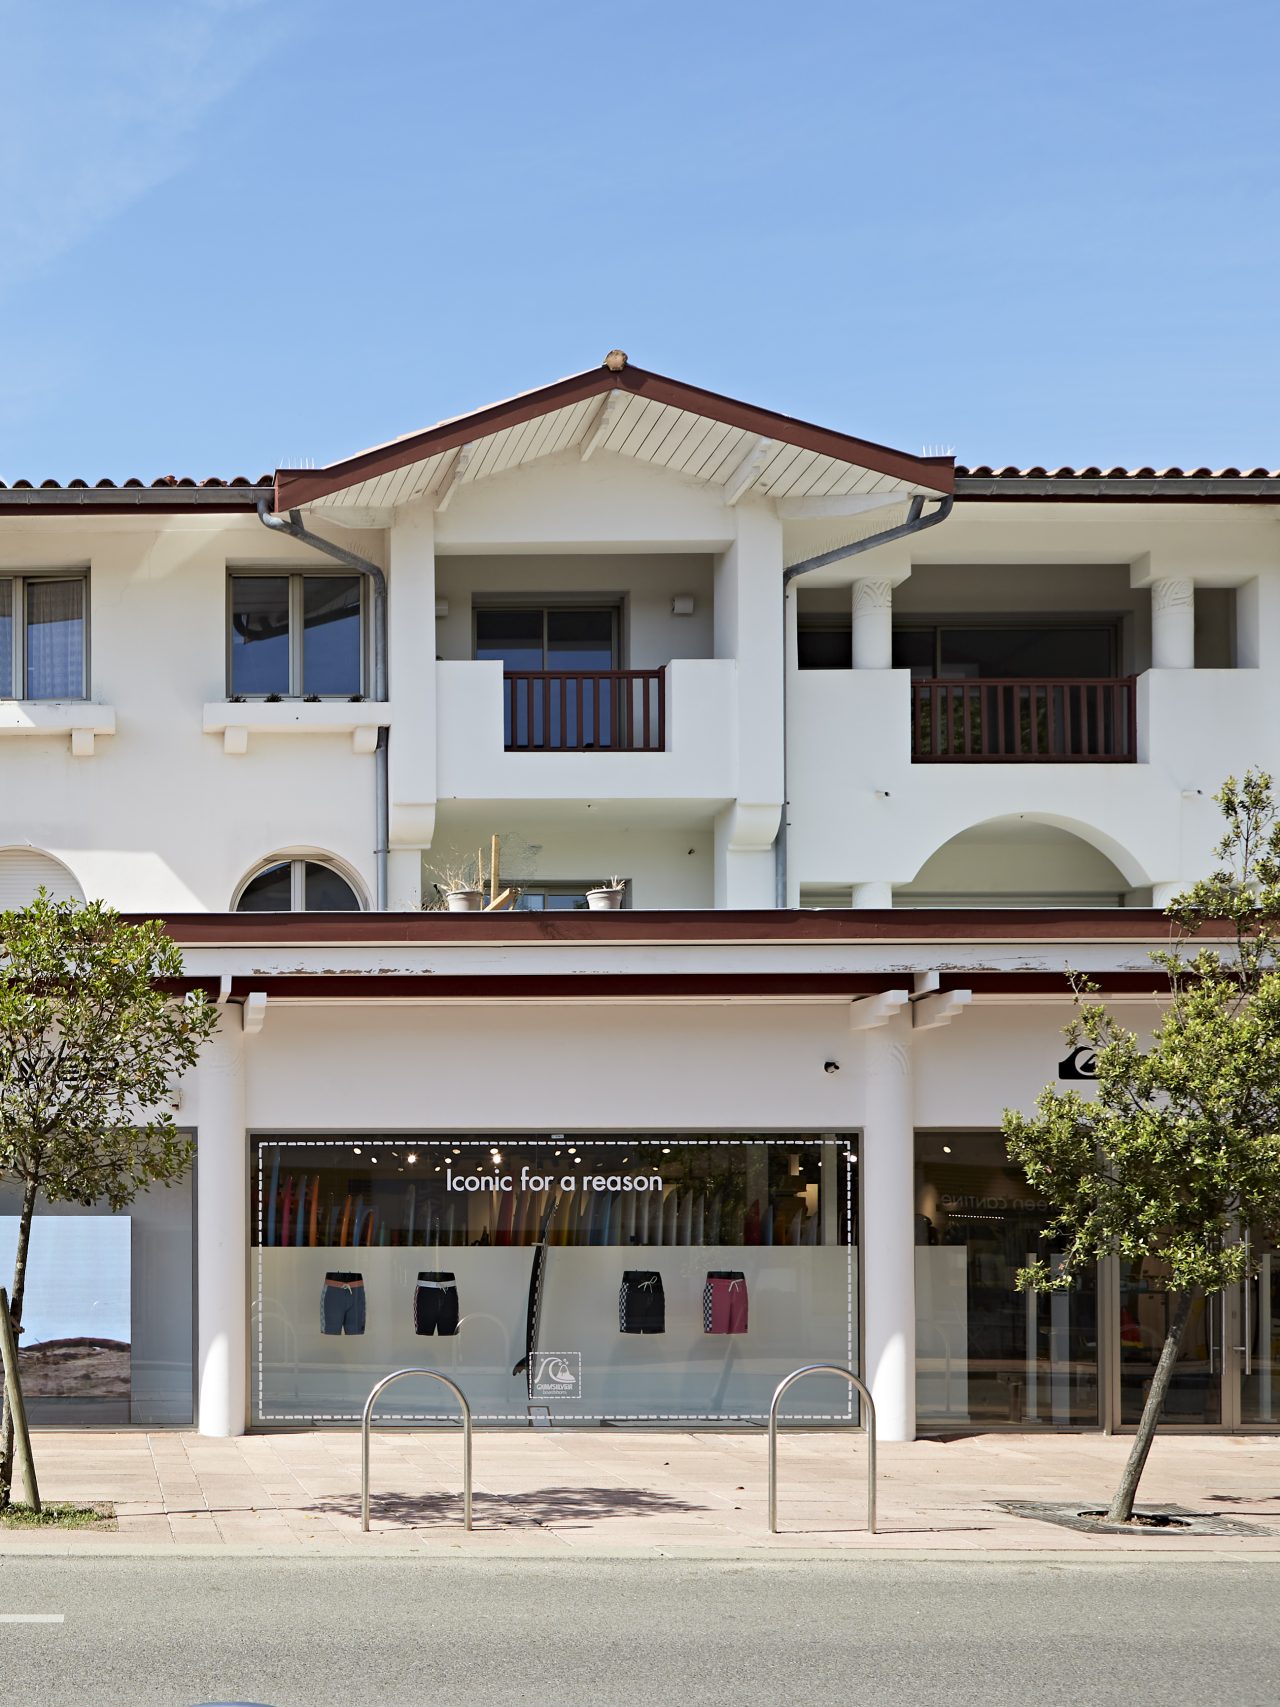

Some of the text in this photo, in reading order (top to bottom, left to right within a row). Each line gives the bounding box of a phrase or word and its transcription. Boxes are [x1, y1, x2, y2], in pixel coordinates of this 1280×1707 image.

[446, 1166, 663, 1191] Iconic for a reason
